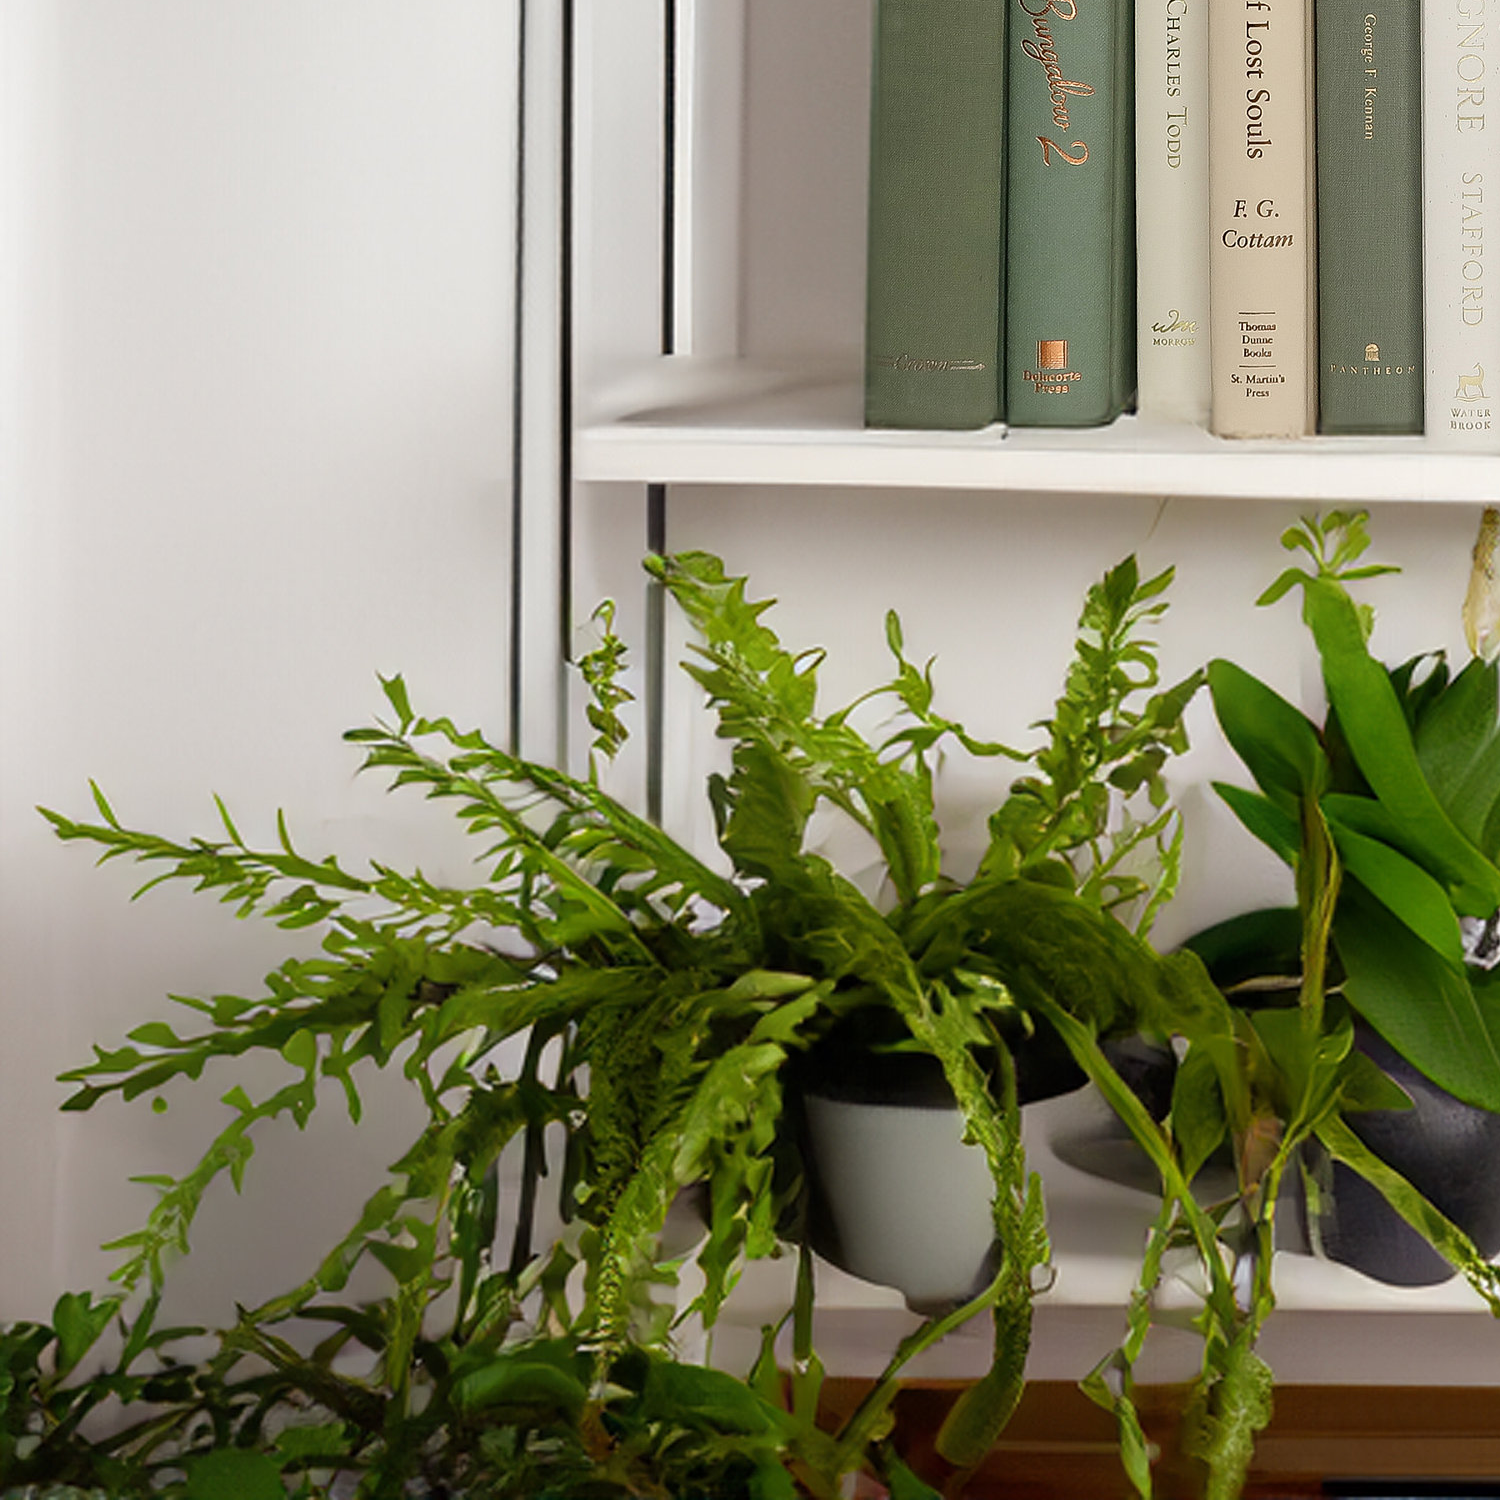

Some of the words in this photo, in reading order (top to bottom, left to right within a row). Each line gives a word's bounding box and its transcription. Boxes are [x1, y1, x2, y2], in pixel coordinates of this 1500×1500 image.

[1360, 13, 1378, 65] George
[1245, 21, 1271, 80] Lost
[1363, 68, 1377, 83] F.
[1363, 88, 1377, 141] Kennan
[1245, 89, 1272, 160] Souls
[1166, 105, 1189, 170] TODD
[1035, 135, 1089, 168] 2
[1233, 200, 1249, 219] F.
[1256, 200, 1280, 219] G.
[1221, 229, 1295, 249] Cottam
[1461, 172, 1484, 327] STAFFORD
[1238, 321, 1277, 332] Thomas
[1152, 337, 1196, 347] MORROW
[1241, 335, 1274, 346] Dunne
[1243, 348, 1272, 359] Books
[1022, 369, 1082, 384] Delacorte
[1329, 364, 1417, 375] PANTHEON
[1230, 373, 1242, 385] St.
[1246, 373, 1286, 385] Martin's
[1033, 381, 1071, 395] Press
[1245, 388, 1270, 399] Press
[1450, 408, 1491, 418] WATER
[1450, 420, 1492, 431] BROOK
